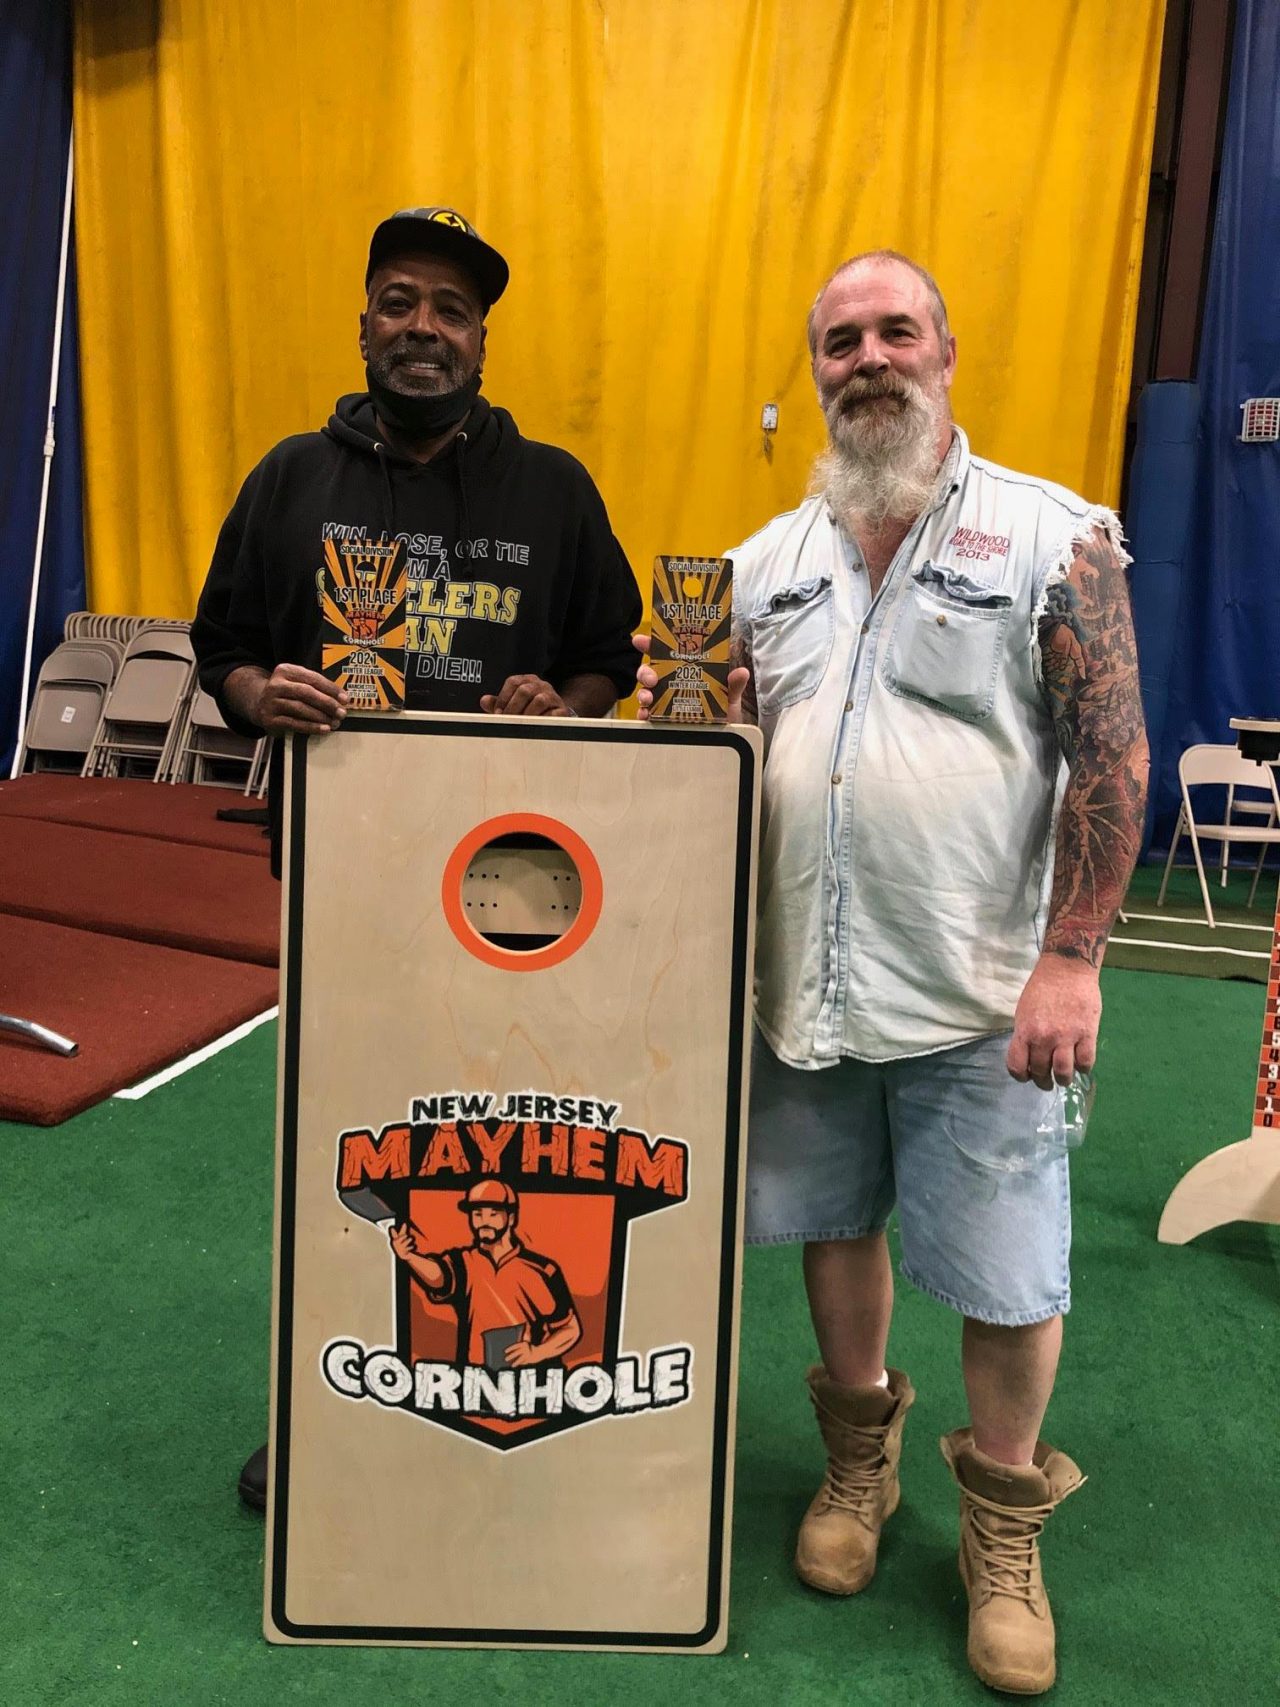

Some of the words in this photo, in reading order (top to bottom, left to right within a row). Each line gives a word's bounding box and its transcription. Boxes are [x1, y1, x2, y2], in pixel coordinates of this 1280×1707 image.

[953, 526, 1010, 549] WILDWOOD
[341, 544, 365, 555] SOCIAL
[366, 545, 394, 557] DIVISION
[455, 538, 488, 559] OR
[495, 540, 530, 565] TIE
[966, 541, 975, 550] TO
[975, 542, 986, 552] THE
[956, 548, 990, 562] 2013
[433, 560, 451, 580] A
[668, 562, 690, 572] SOCIAL
[692, 563, 720, 573] DIVISION
[334, 587, 357, 602] 1ST
[359, 587, 397, 605] PLACE
[663, 604, 683, 619] 1ST
[686, 604, 722, 620] PLACE
[343, 634, 385, 646] CORNHOLE
[349, 651, 378, 665] 2021
[342, 666, 363, 675] WINTER
[364, 667, 384, 676] LEAGUE
[416, 654, 482, 683] DIE!!!
[676, 666, 702, 679] 2021
[669, 681, 689, 689] WINTER
[690, 682, 709, 690] LEAGUE
[1272, 1031, 1280, 1046] 5
[1269, 1048, 1279, 1062] 4
[1268, 1064, 1278, 1078] 3
[1267, 1081, 1276, 1095] 2
[412, 1094, 493, 1122] NEW
[498, 1094, 618, 1126] JERSEY
[1264, 1096, 1274, 1112] 1
[342, 1122, 687, 1197] MAYHEM
[324, 1341, 690, 1416] CORNHOLE
